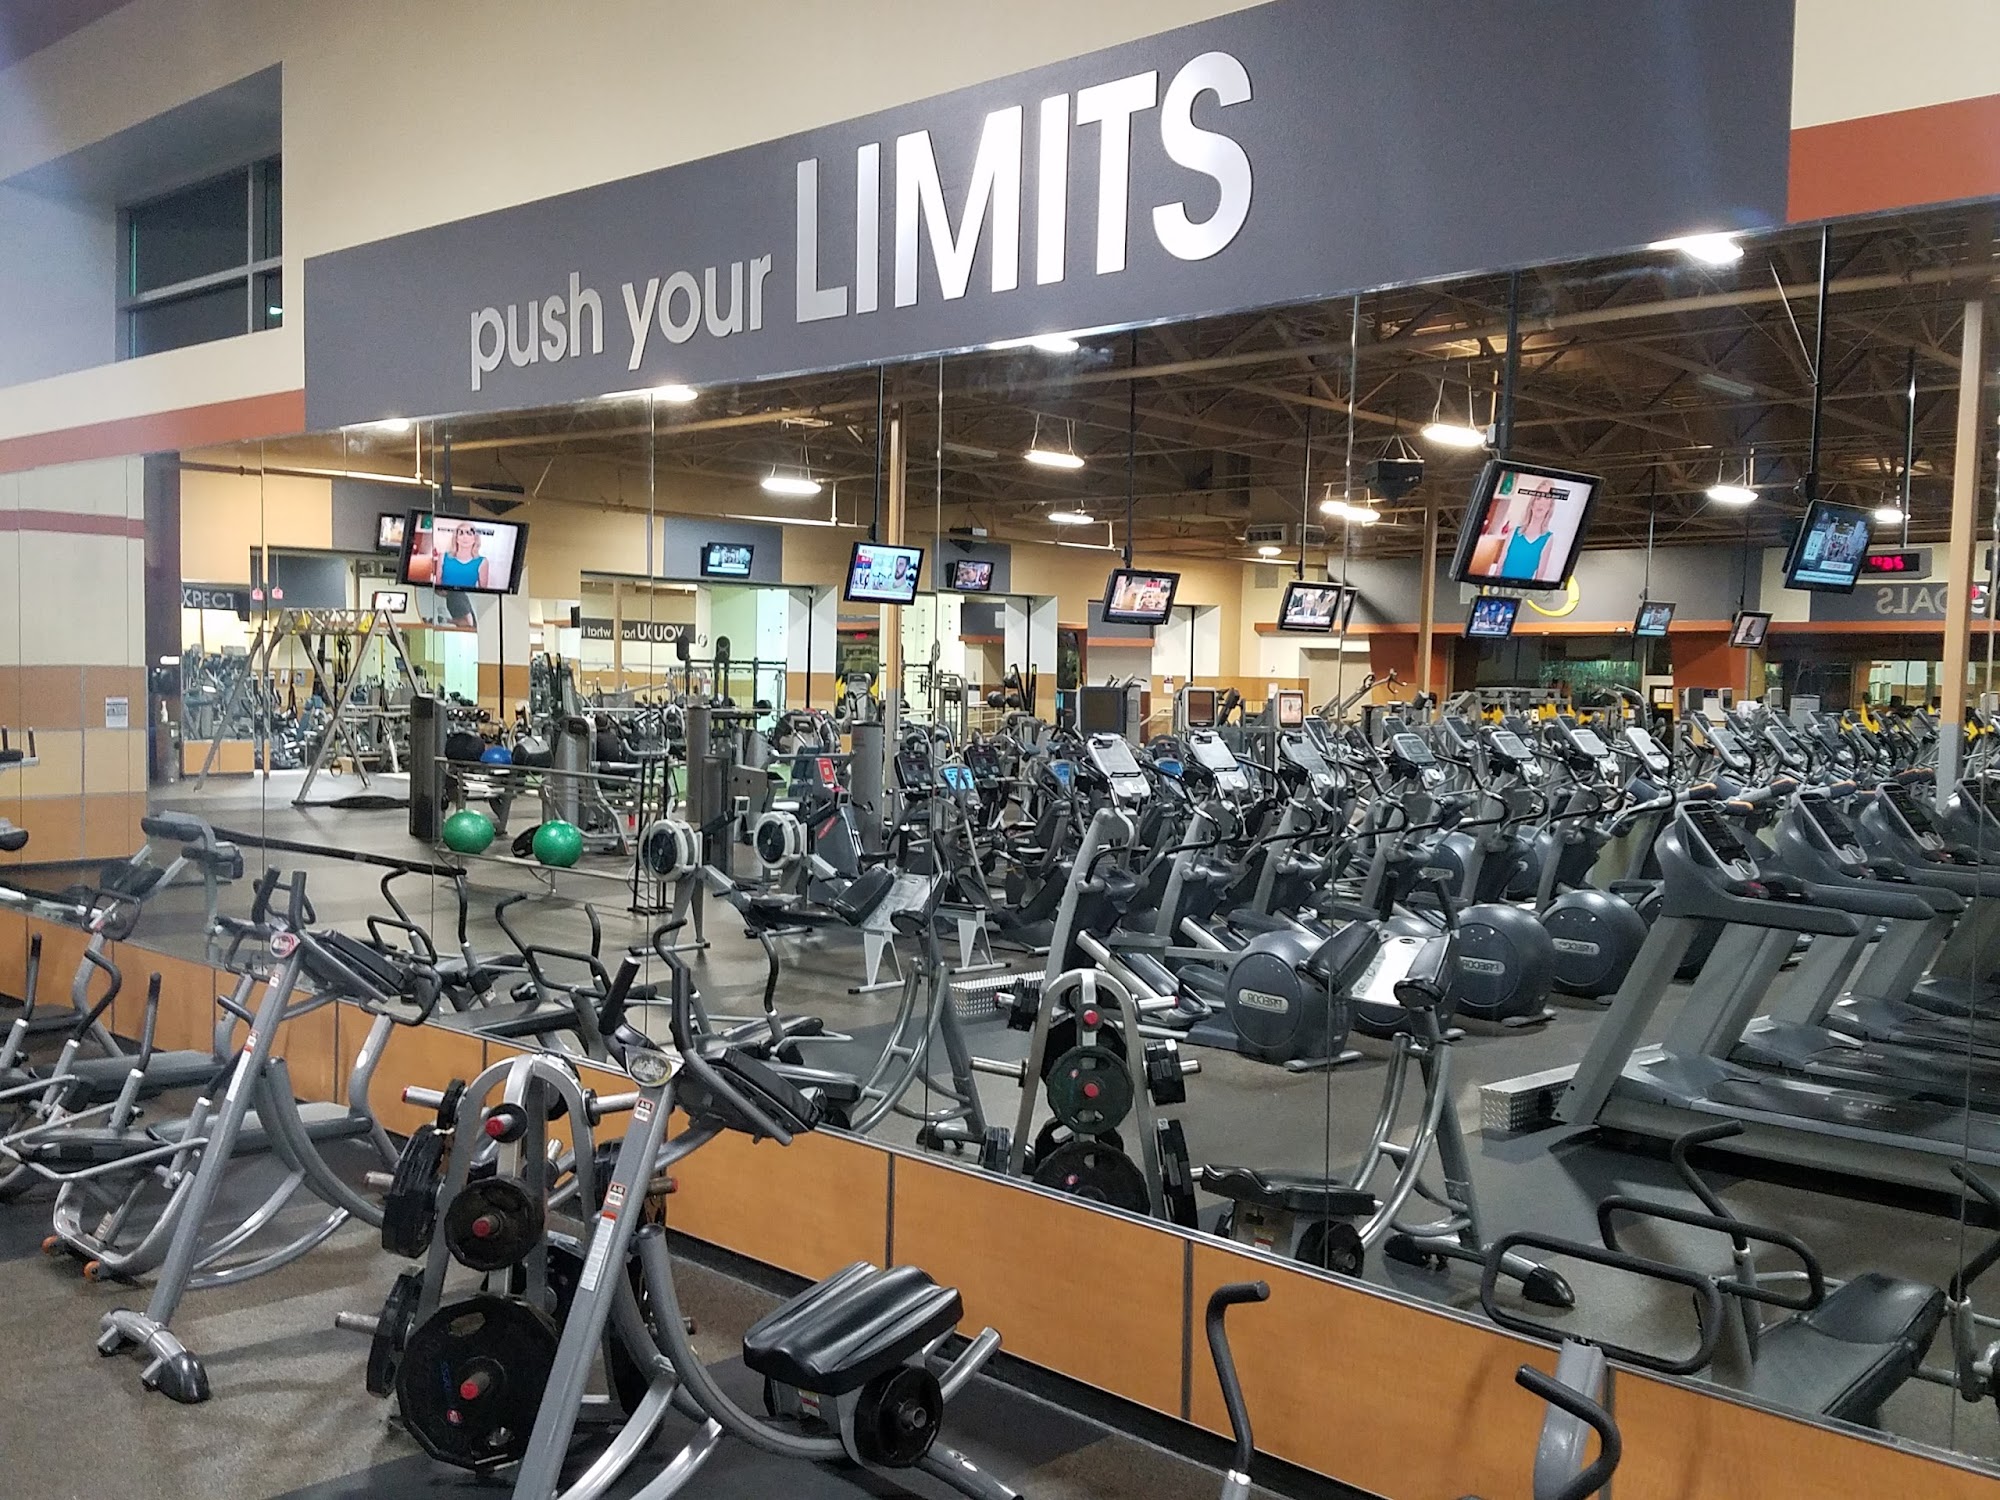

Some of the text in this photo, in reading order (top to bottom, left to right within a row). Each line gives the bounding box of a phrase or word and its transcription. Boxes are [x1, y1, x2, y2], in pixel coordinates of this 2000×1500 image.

[471, 51, 1254, 392] push your LIMITS
